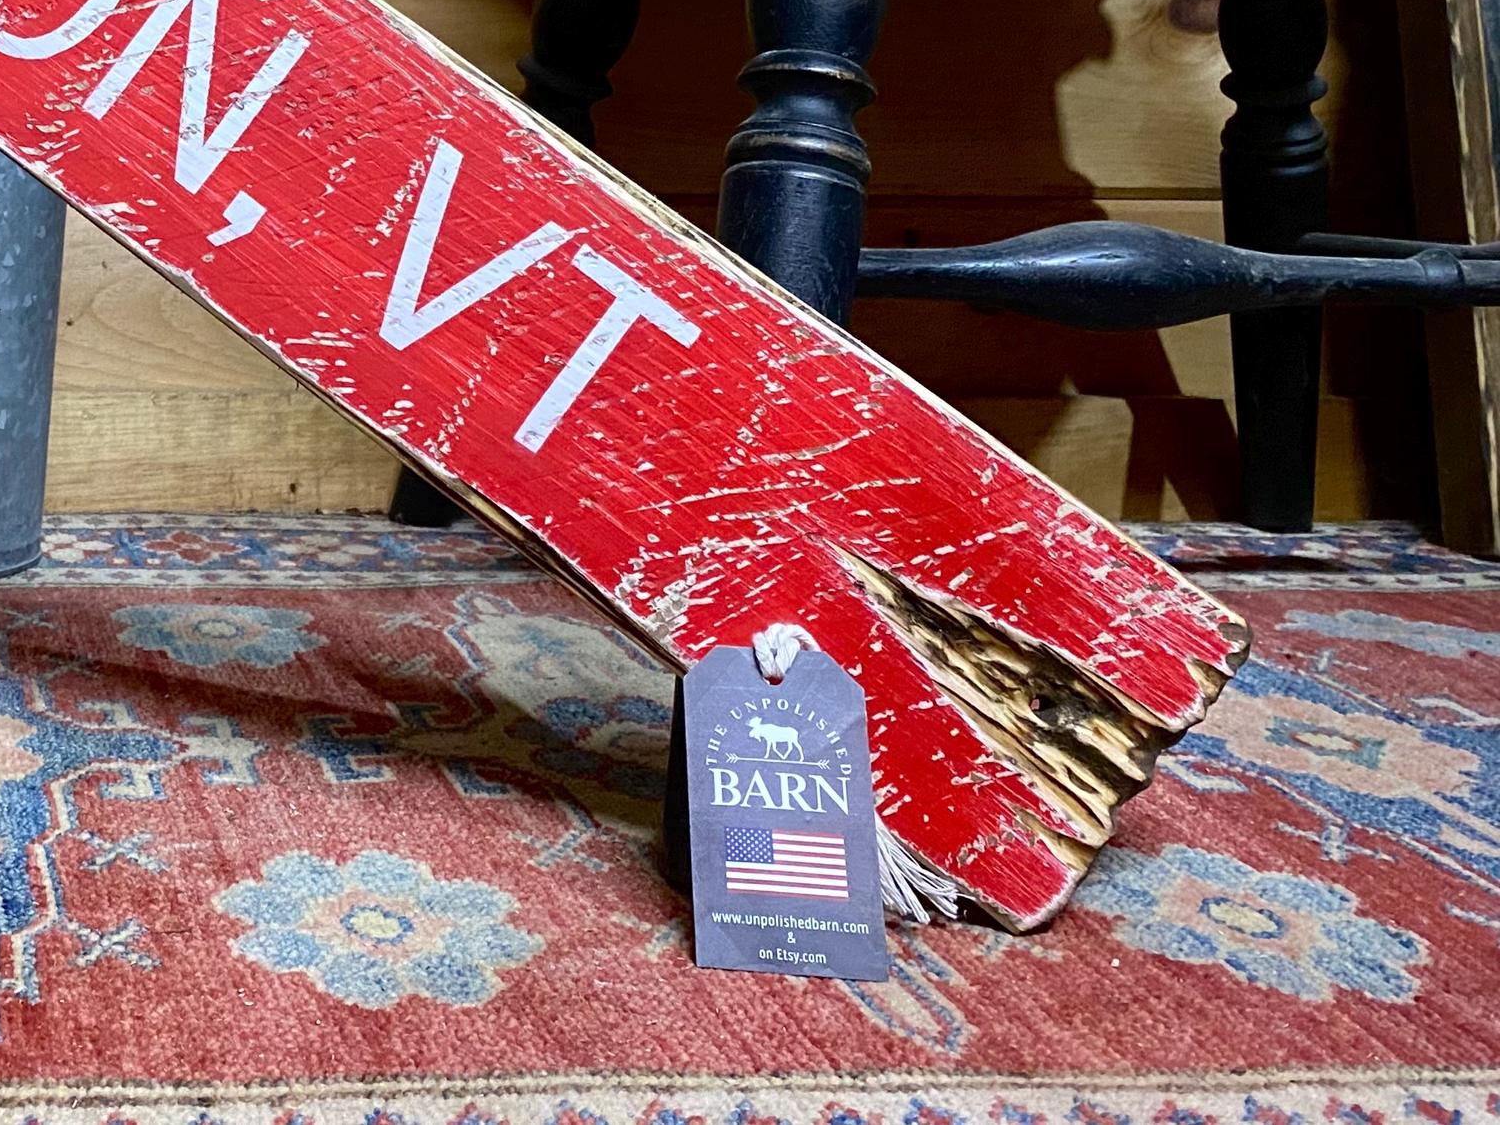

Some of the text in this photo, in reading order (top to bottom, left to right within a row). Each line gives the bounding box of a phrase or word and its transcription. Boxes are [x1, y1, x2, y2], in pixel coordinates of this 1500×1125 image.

[379, 138, 702, 453] VT
[705, 698, 852, 775] THE UNPOLISHED
[708, 768, 851, 816] BARN
[711, 912, 870, 935] www.unpolishedbarn.com
[787, 931, 796, 944] &
[759, 948, 827, 964] on Etsy.com
